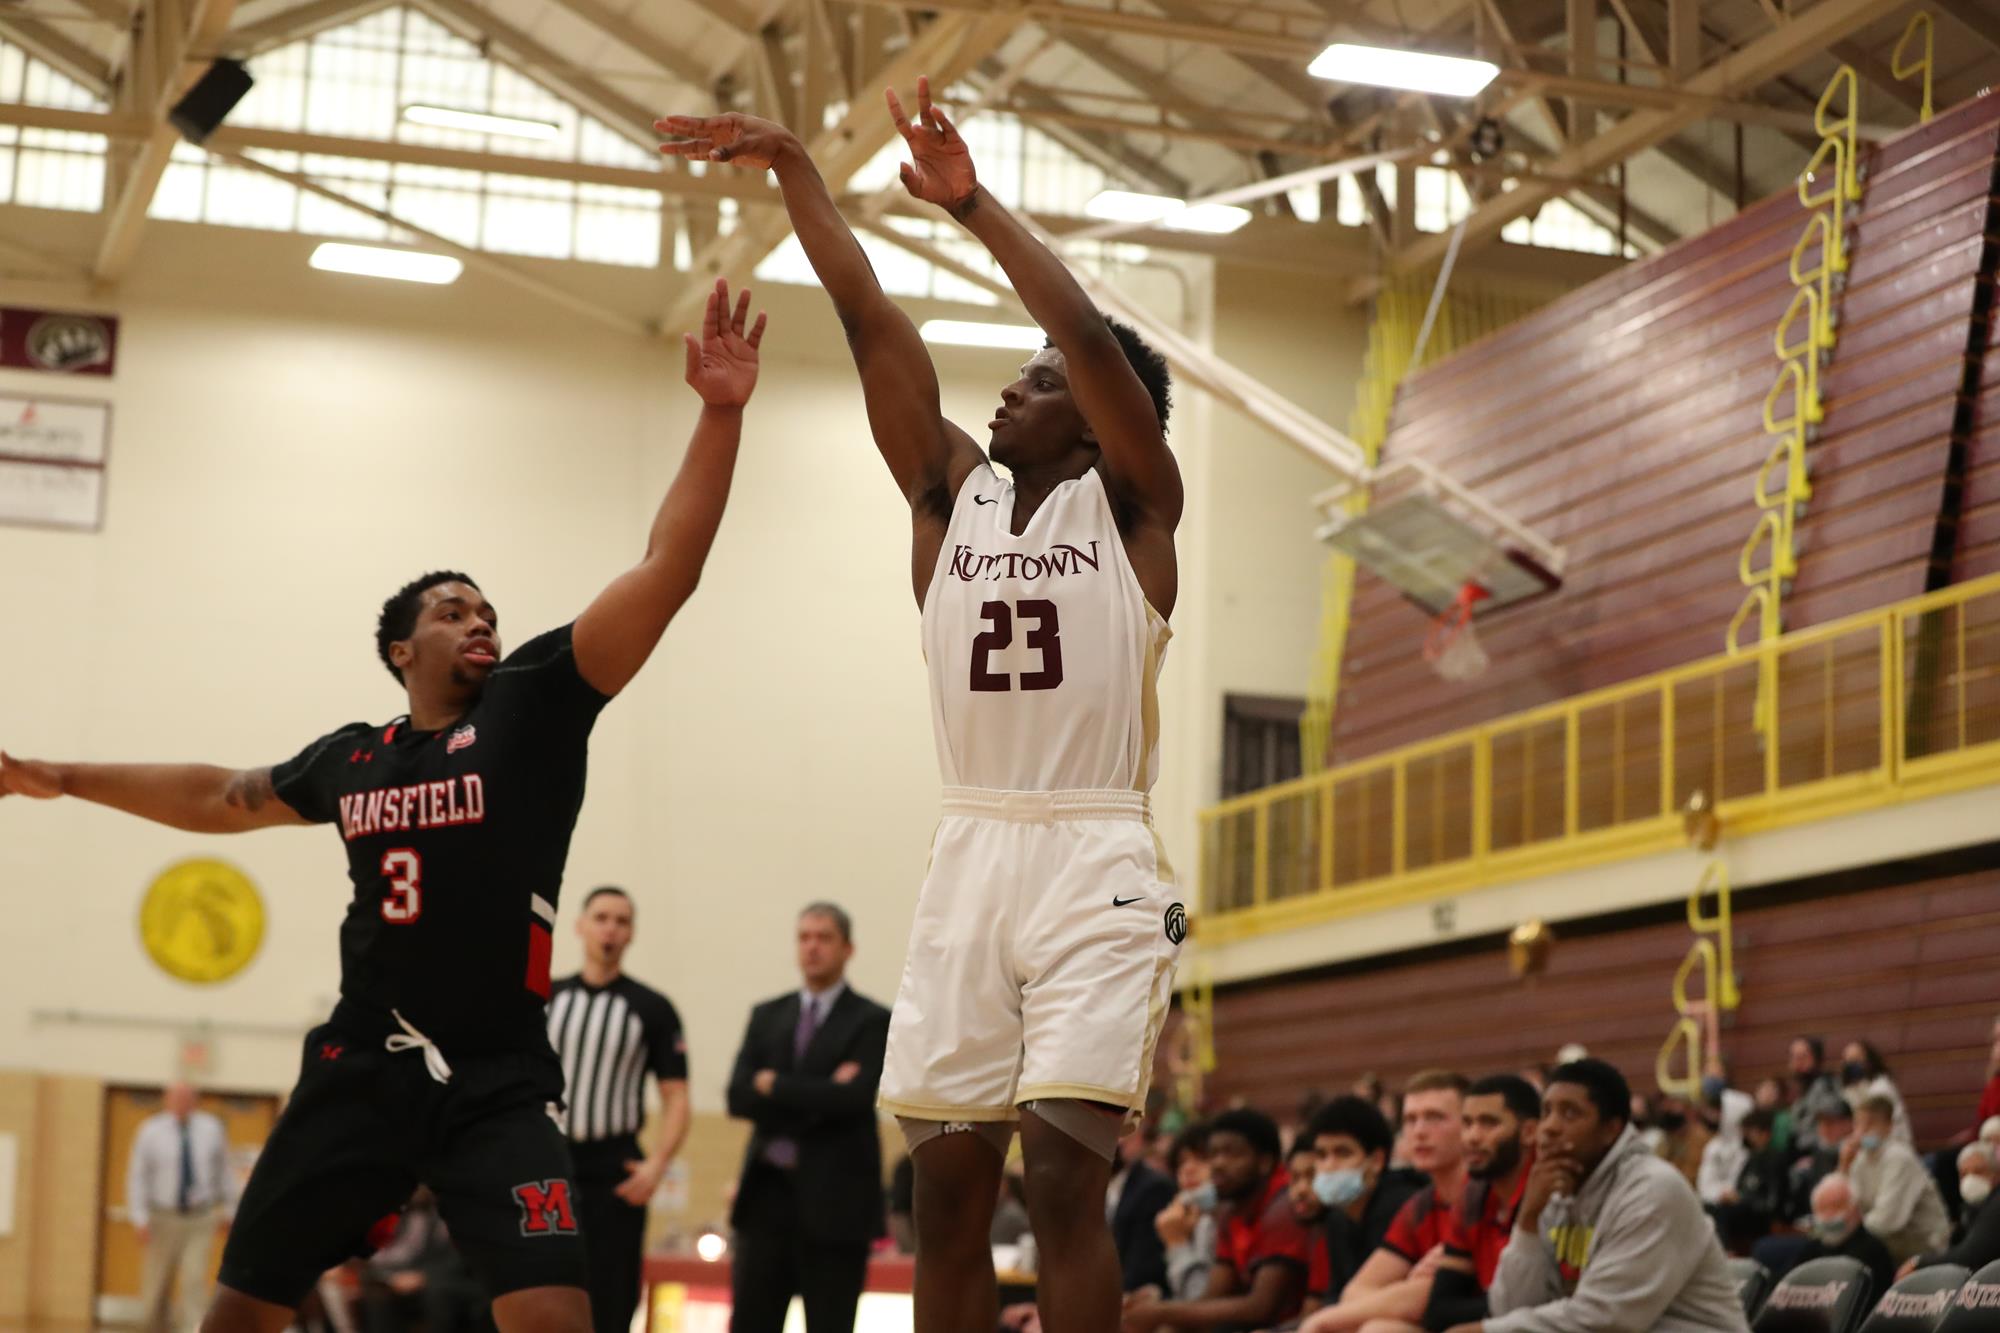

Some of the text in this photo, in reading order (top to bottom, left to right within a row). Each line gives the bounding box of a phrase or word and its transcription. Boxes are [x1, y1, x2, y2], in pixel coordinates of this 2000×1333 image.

[970, 599, 1064, 692] 23
[380, 847, 422, 925] 3
[511, 1178, 578, 1237] M
